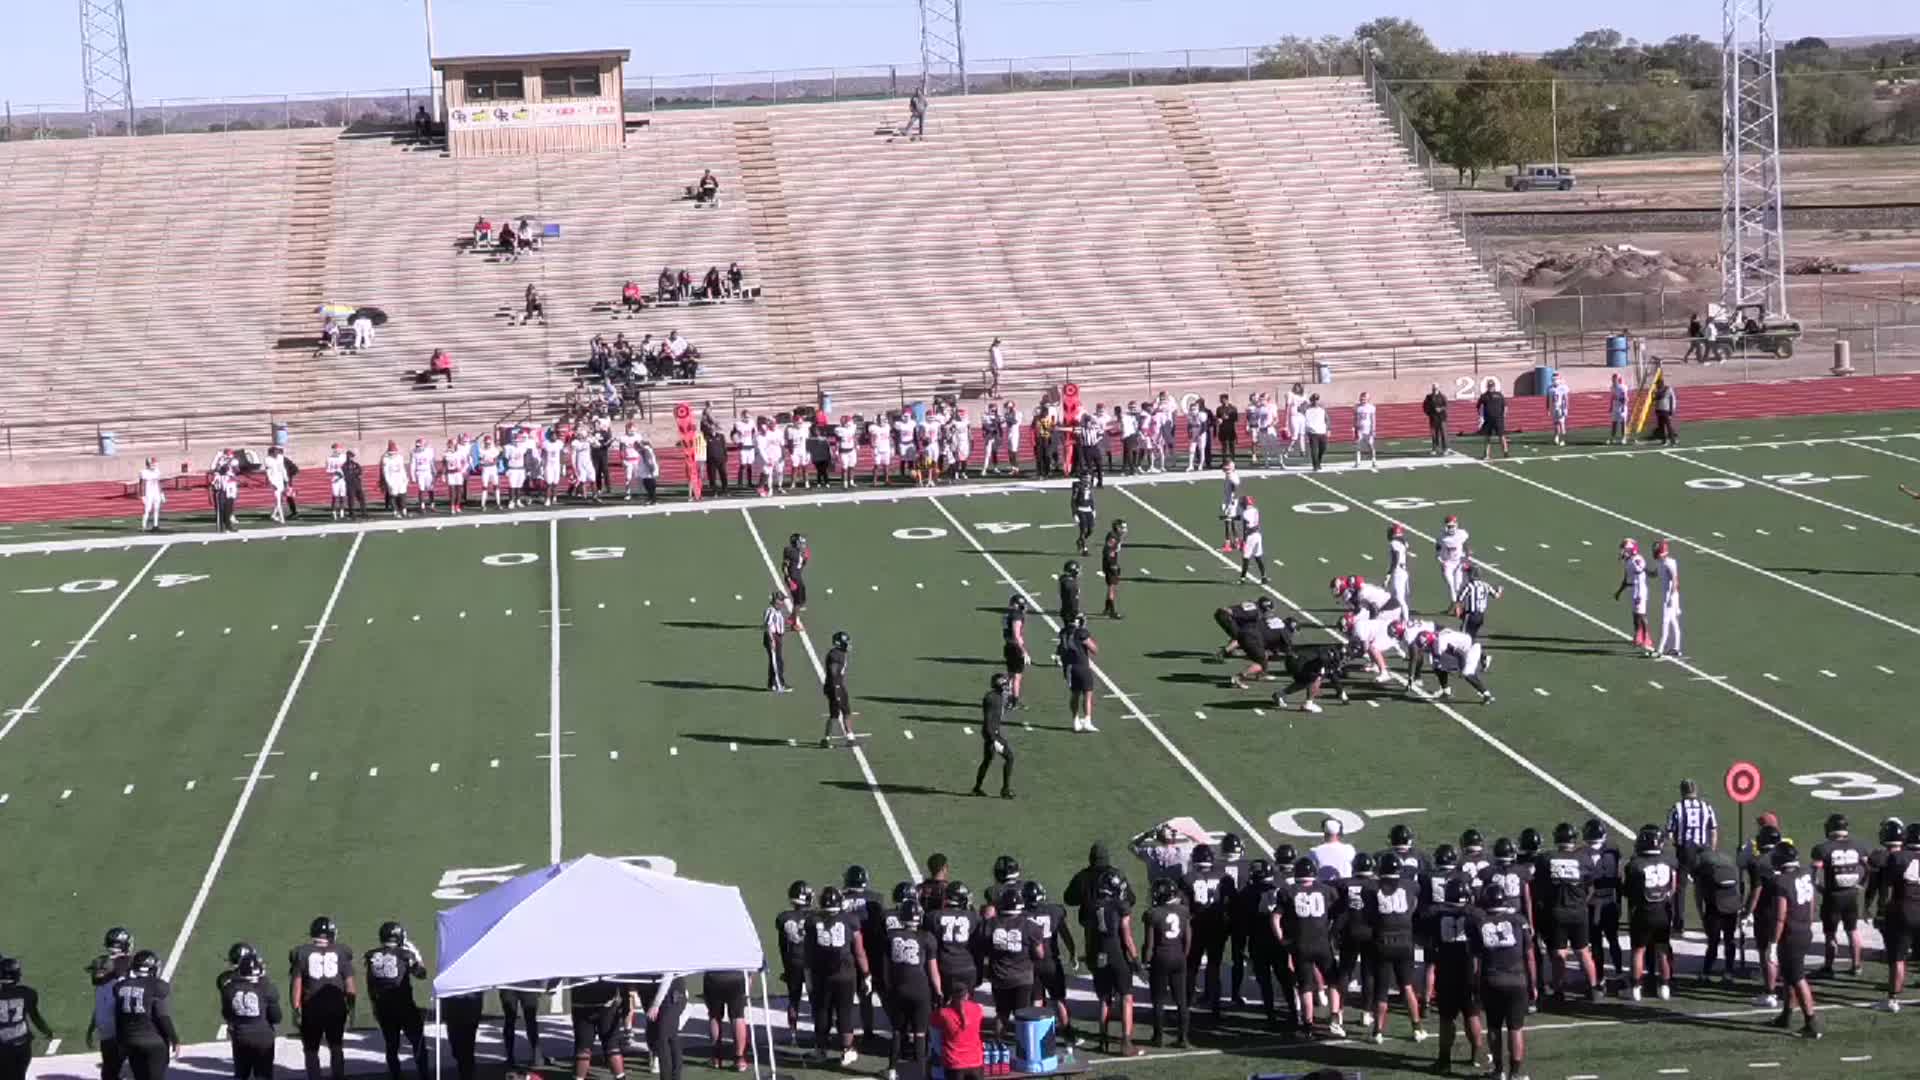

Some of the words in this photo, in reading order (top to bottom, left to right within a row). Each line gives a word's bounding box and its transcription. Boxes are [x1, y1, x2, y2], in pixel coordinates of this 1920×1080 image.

[1788, 771, 1904, 800] 3
[1293, 891, 1326, 918] 60
[940, 915, 970, 943] 73
[1165, 912, 1181, 939] 3
[118, 986, 146, 1014] 77
